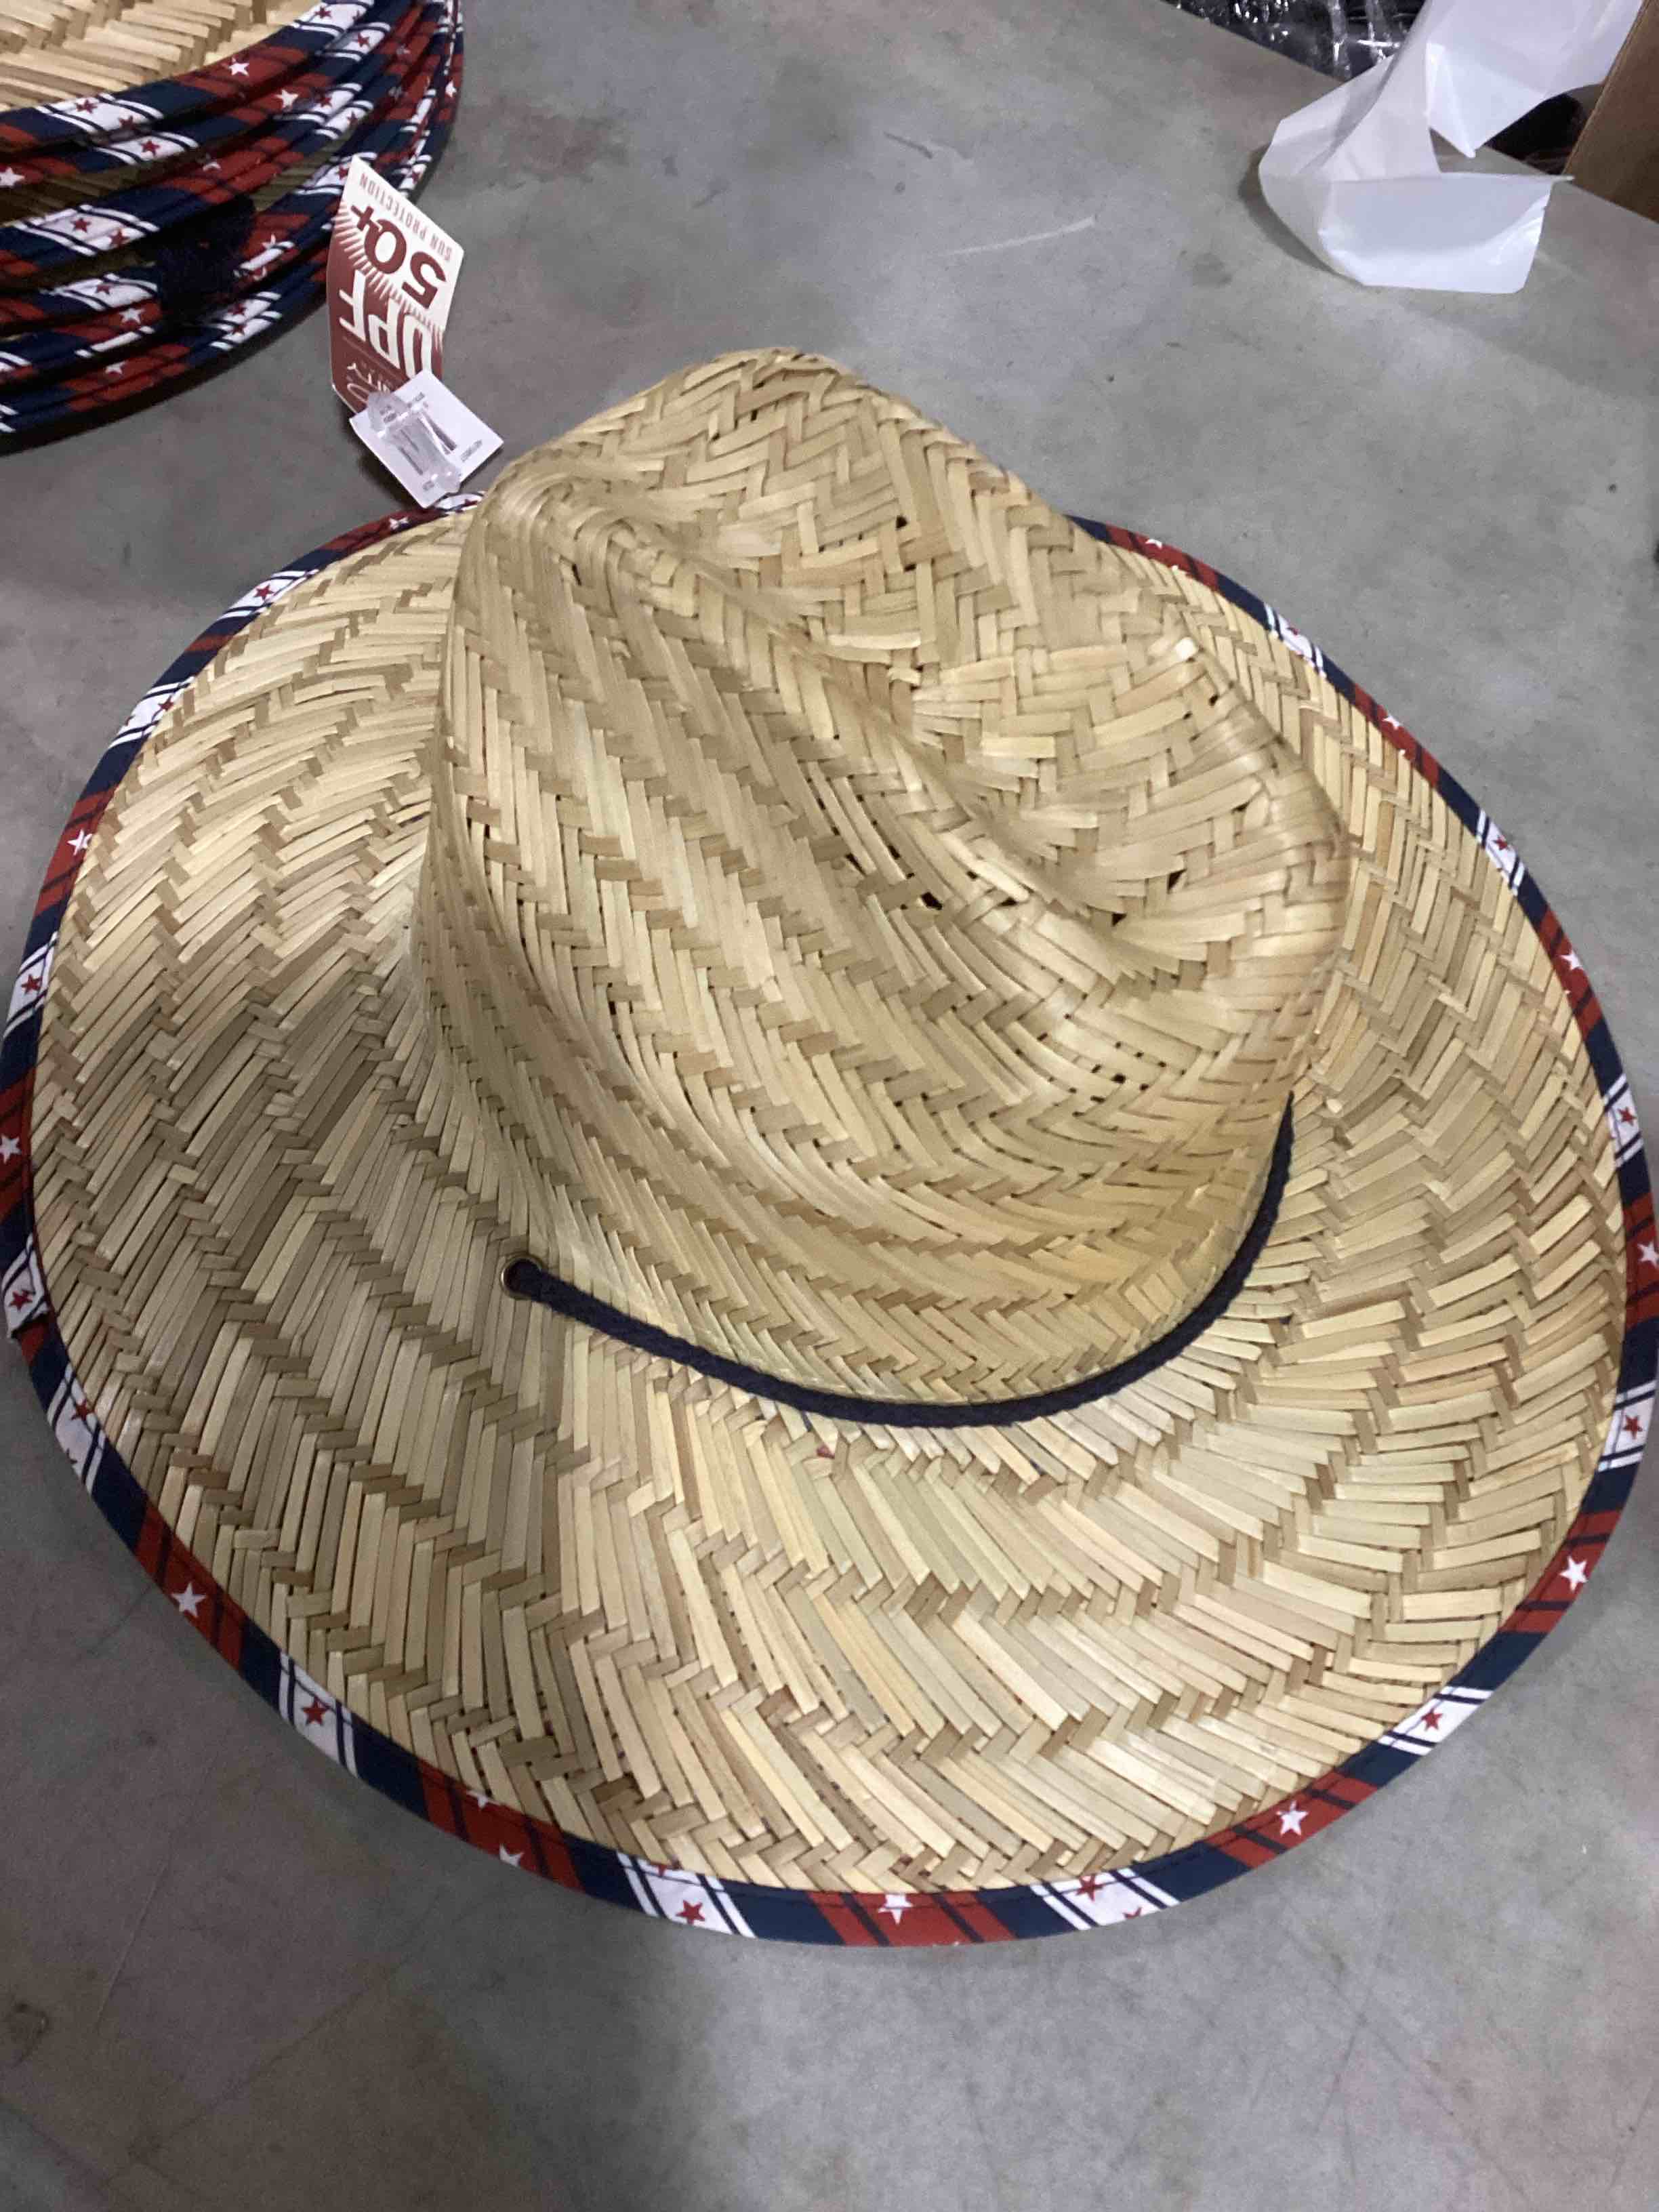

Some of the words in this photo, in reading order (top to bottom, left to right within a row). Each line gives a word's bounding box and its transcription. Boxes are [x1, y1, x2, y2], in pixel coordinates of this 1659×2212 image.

[359, 172, 428, 241] PROTECTION
[430, 234, 453, 262] SUN
[350, 205, 447, 309] 50+
[339, 269, 432, 380] UPF
